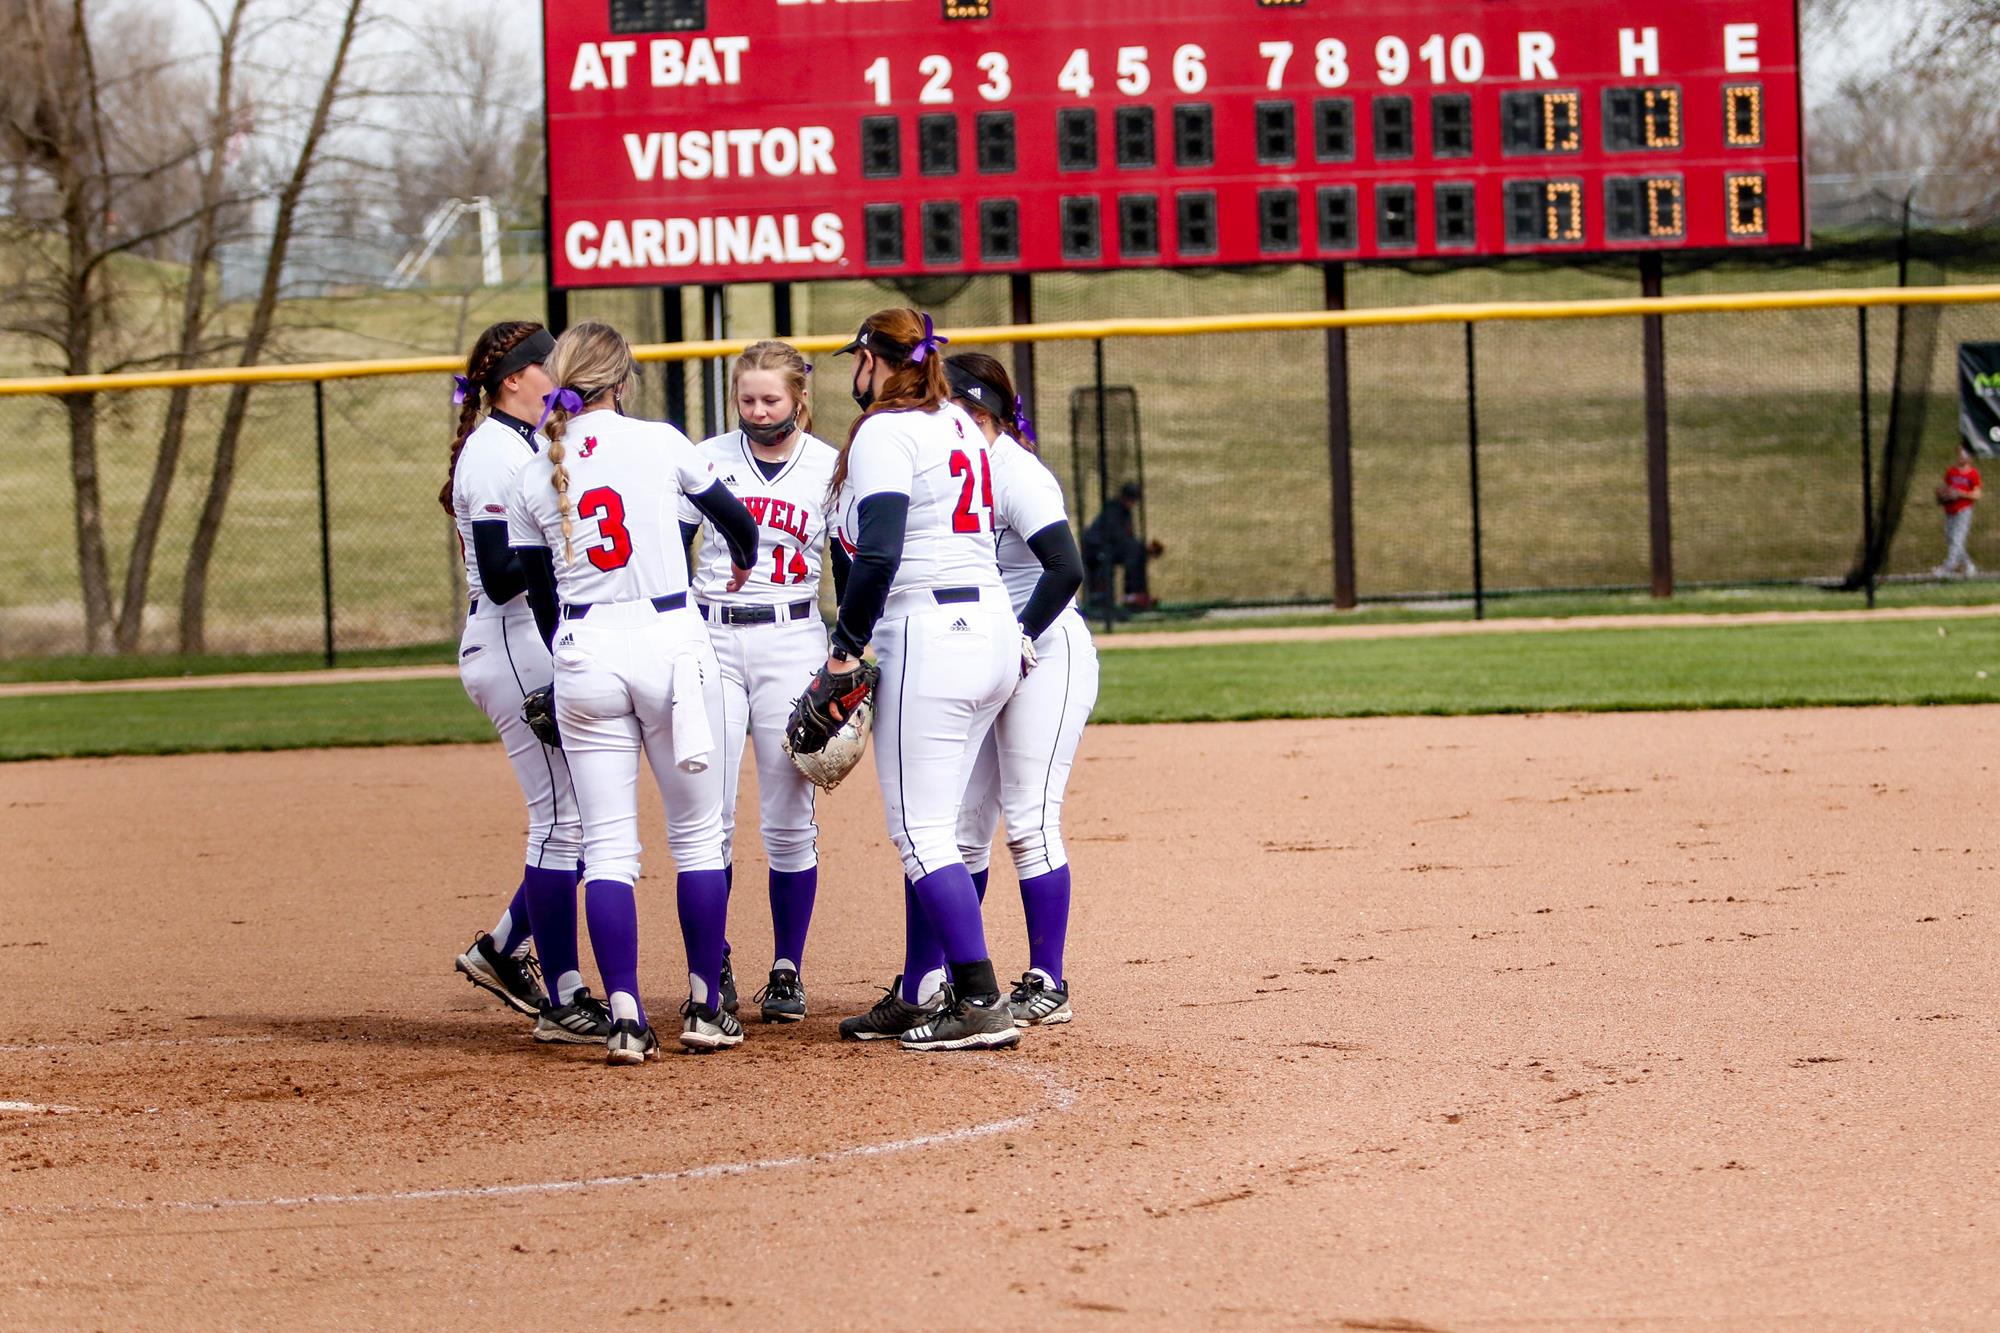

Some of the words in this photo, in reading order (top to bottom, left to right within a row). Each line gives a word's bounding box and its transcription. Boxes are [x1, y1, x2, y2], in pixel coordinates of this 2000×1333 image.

[569, 41, 637, 91] AT
[650, 36, 750, 87] BAT
[864, 57, 891, 106] 1
[918, 54, 954, 104] 2
[977, 51, 1012, 101] 3
[1057, 48, 1095, 98] 4
[1116, 46, 1151, 96] 5
[1172, 43, 1208, 94] 6
[1259, 41, 1294, 91] 7
[1315, 37, 1350, 88] 8
[1375, 35, 1410, 86] 9
[1419, 33, 1485, 85] 10
[1518, 31, 1559, 81] R
[1619, 27, 1659, 78] H
[1723, 23, 1760, 74] E
[623, 126, 837, 181] VISITOR
[565, 213, 844, 269] CARDINALS
[577, 486, 633, 573] 3
[738, 496, 809, 545] WELL
[770, 545, 808, 585] 14
